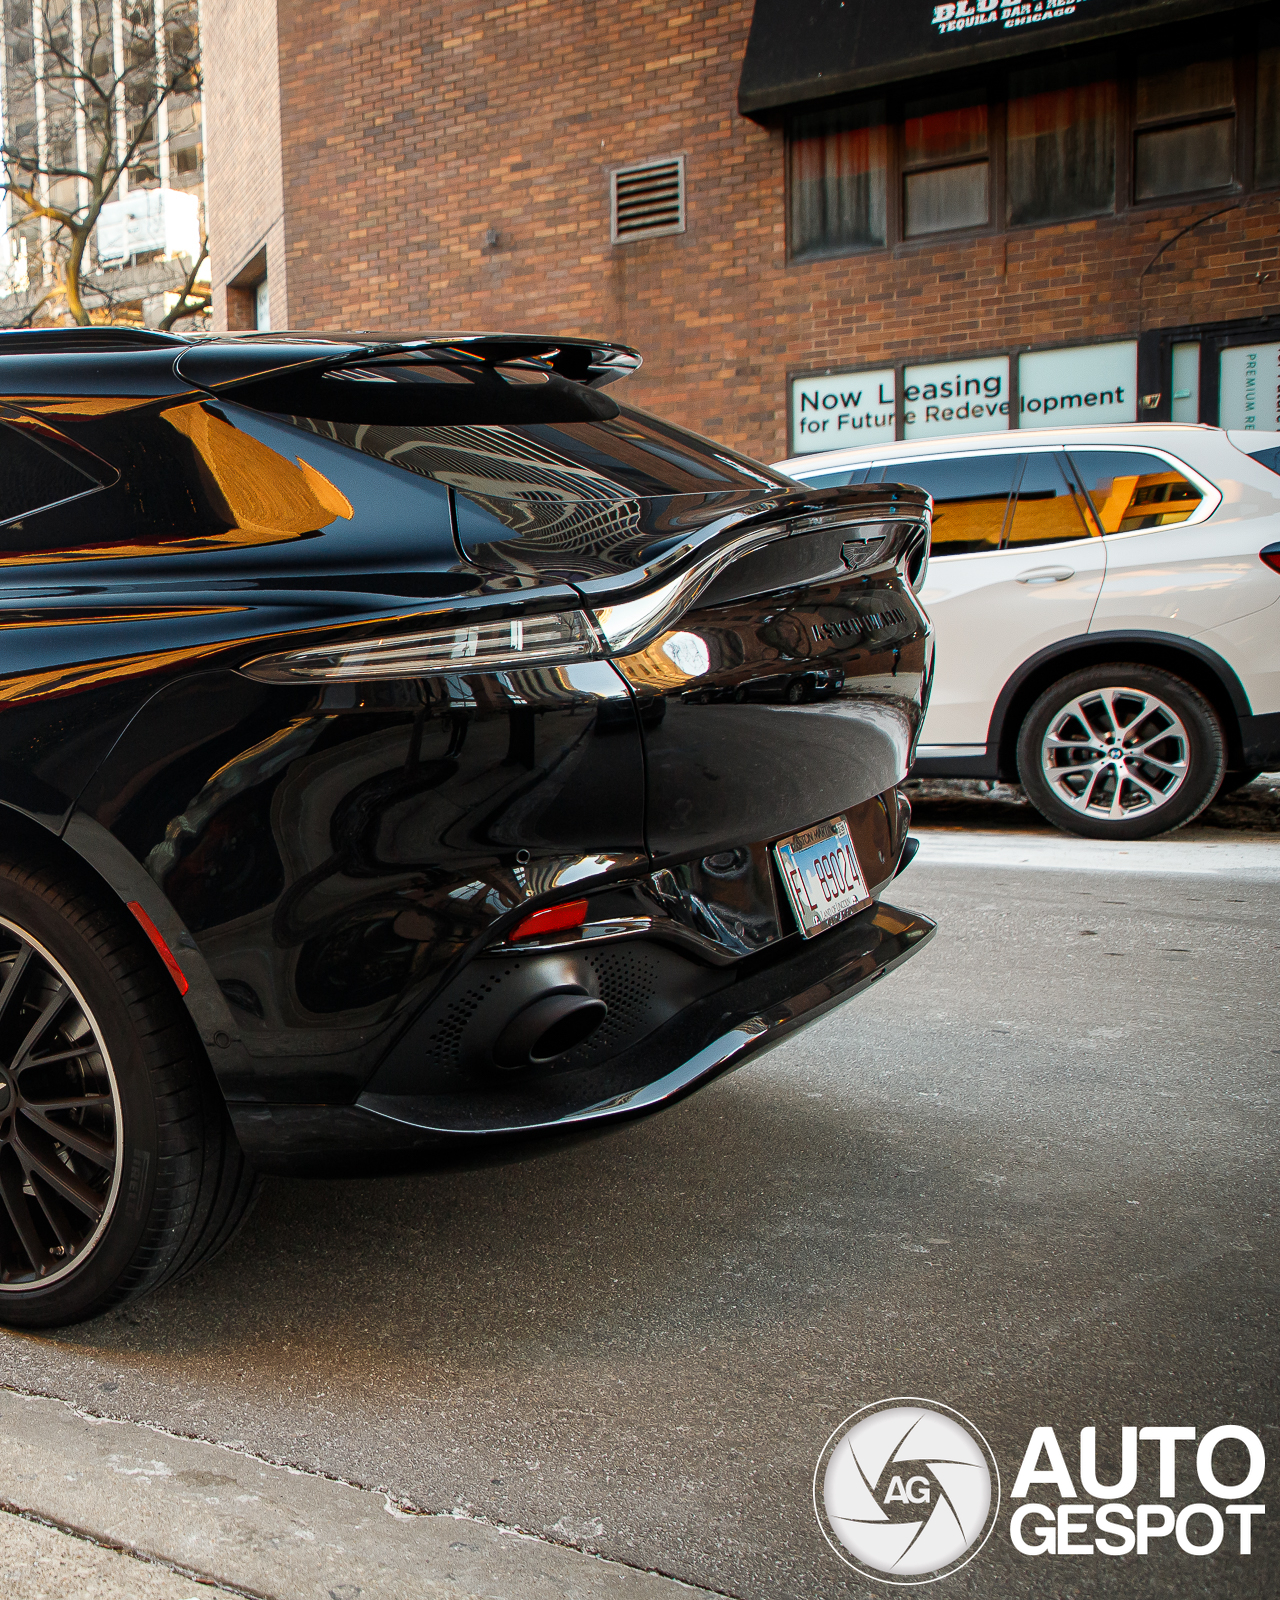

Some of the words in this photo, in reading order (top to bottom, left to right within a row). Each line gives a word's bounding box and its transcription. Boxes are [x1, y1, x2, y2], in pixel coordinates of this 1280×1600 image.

[938, 10, 998, 34] TEQUILA
[1003, 5, 1077, 29] CHICAGO
[801, 390, 862, 411] Now
[878, 374, 1001, 404] Leasing
[1245, 353, 1257, 411] PREMIUM
[800, 417, 829, 434] for
[838, 411, 916, 430] Future
[926, 386, 1125, 422] Redevelopment
[790, 867, 818, 915] FL
[814, 845, 861, 902] 89024
